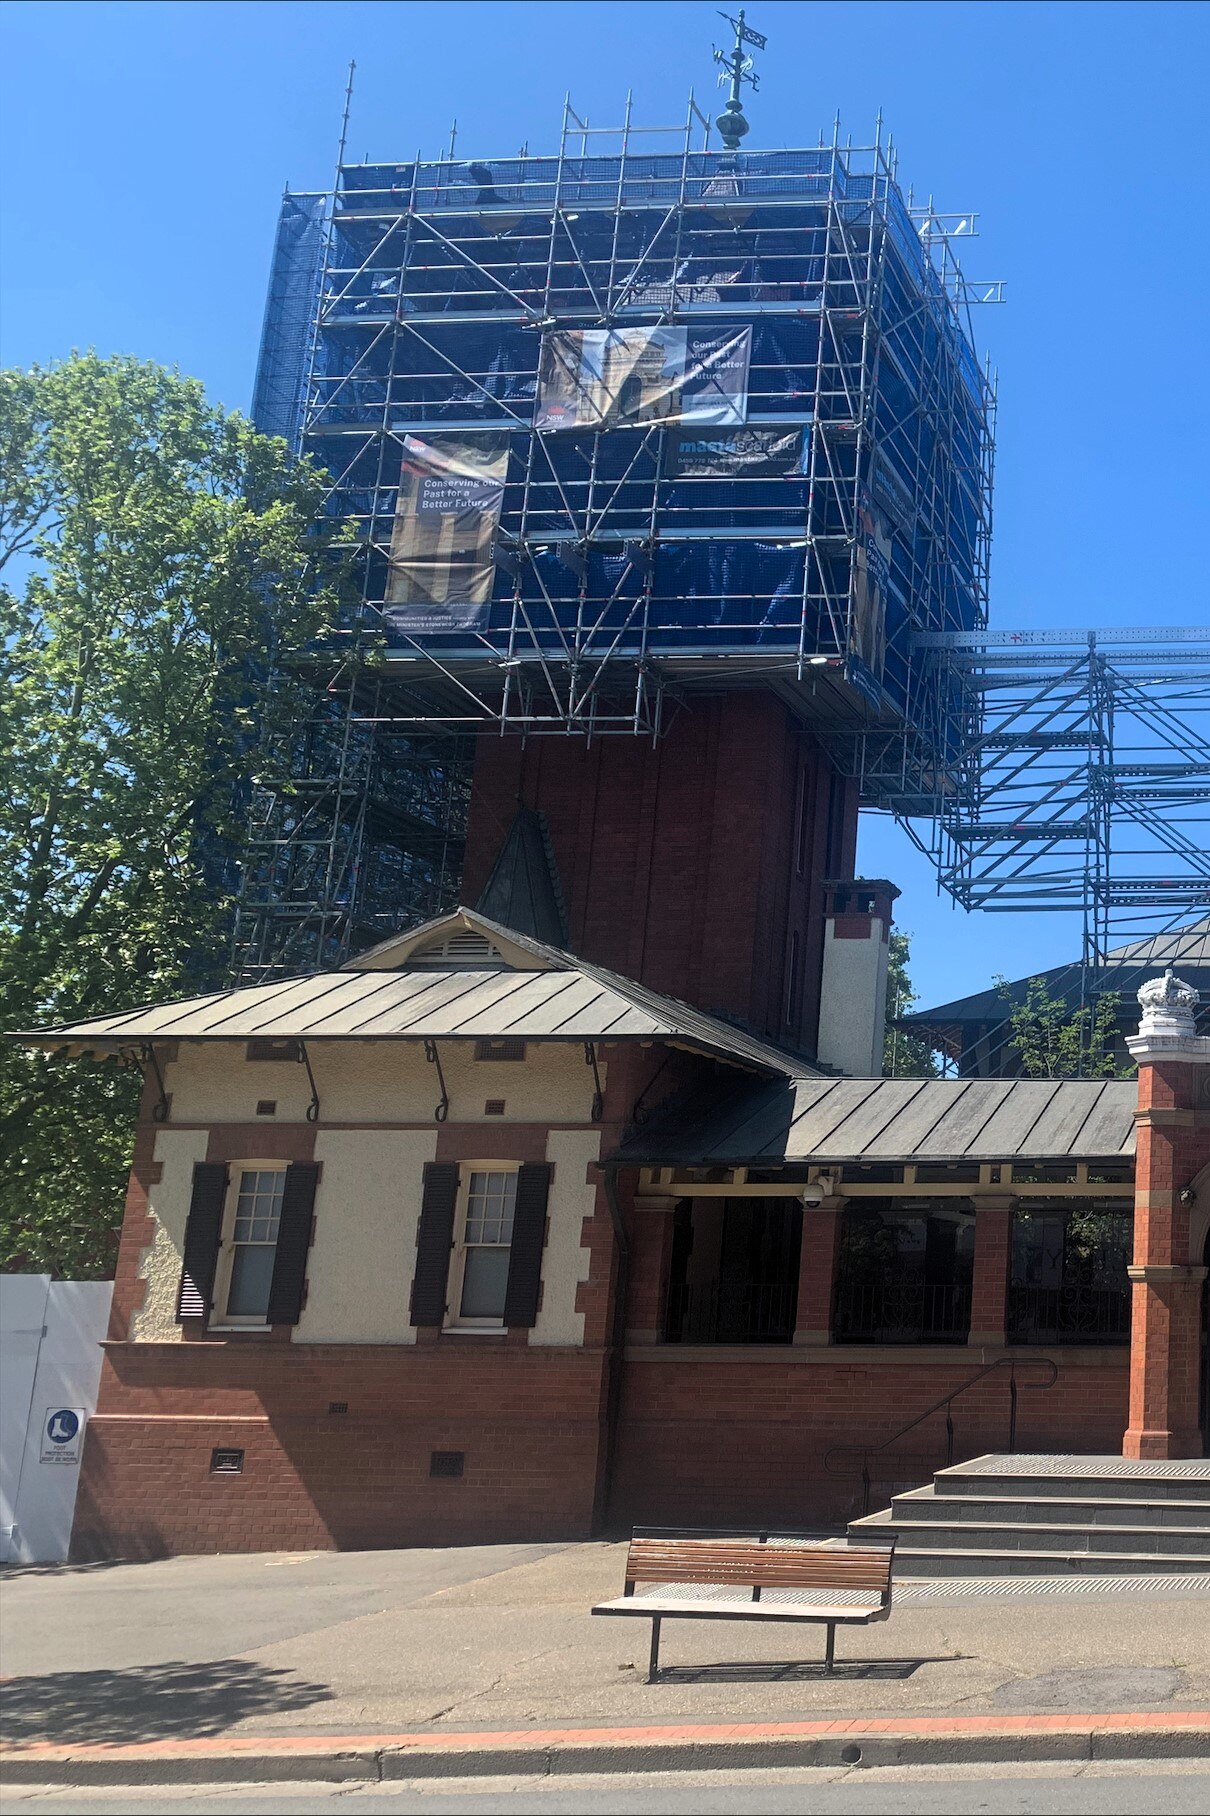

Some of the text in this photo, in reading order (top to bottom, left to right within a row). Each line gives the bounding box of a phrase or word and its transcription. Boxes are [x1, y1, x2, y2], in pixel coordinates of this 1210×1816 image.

[692, 340, 747, 349] Conserng
[710, 351, 731, 359] Pst
[714, 361, 744, 369] Better
[679, 440, 796, 453] mastascafold
[424, 479, 480, 488] Conserving
[423, 490, 445, 498] Past
[447, 489, 461, 497] for
[422, 499, 489, 509] Better Future
